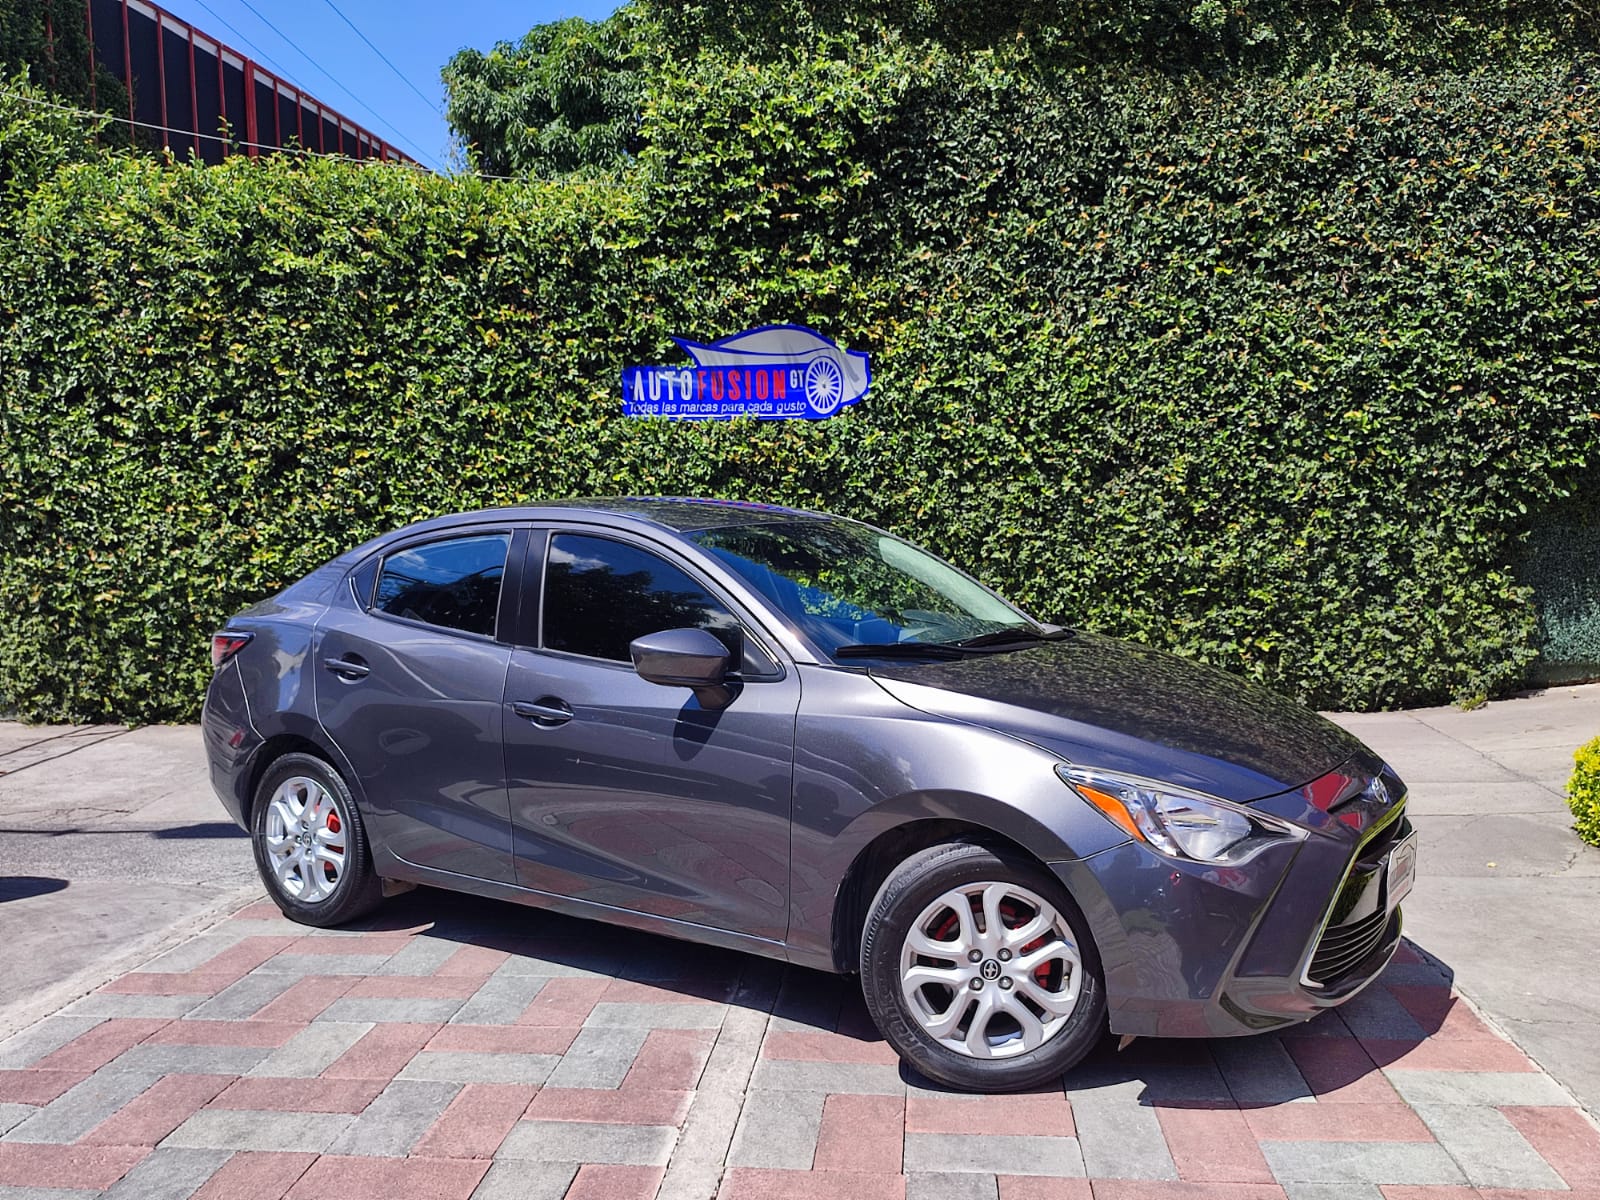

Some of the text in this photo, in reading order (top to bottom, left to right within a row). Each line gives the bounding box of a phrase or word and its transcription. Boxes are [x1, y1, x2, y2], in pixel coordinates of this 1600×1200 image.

[789, 369, 804, 389] GT
[629, 401, 806, 414] Todas las marcas para cada gusto
